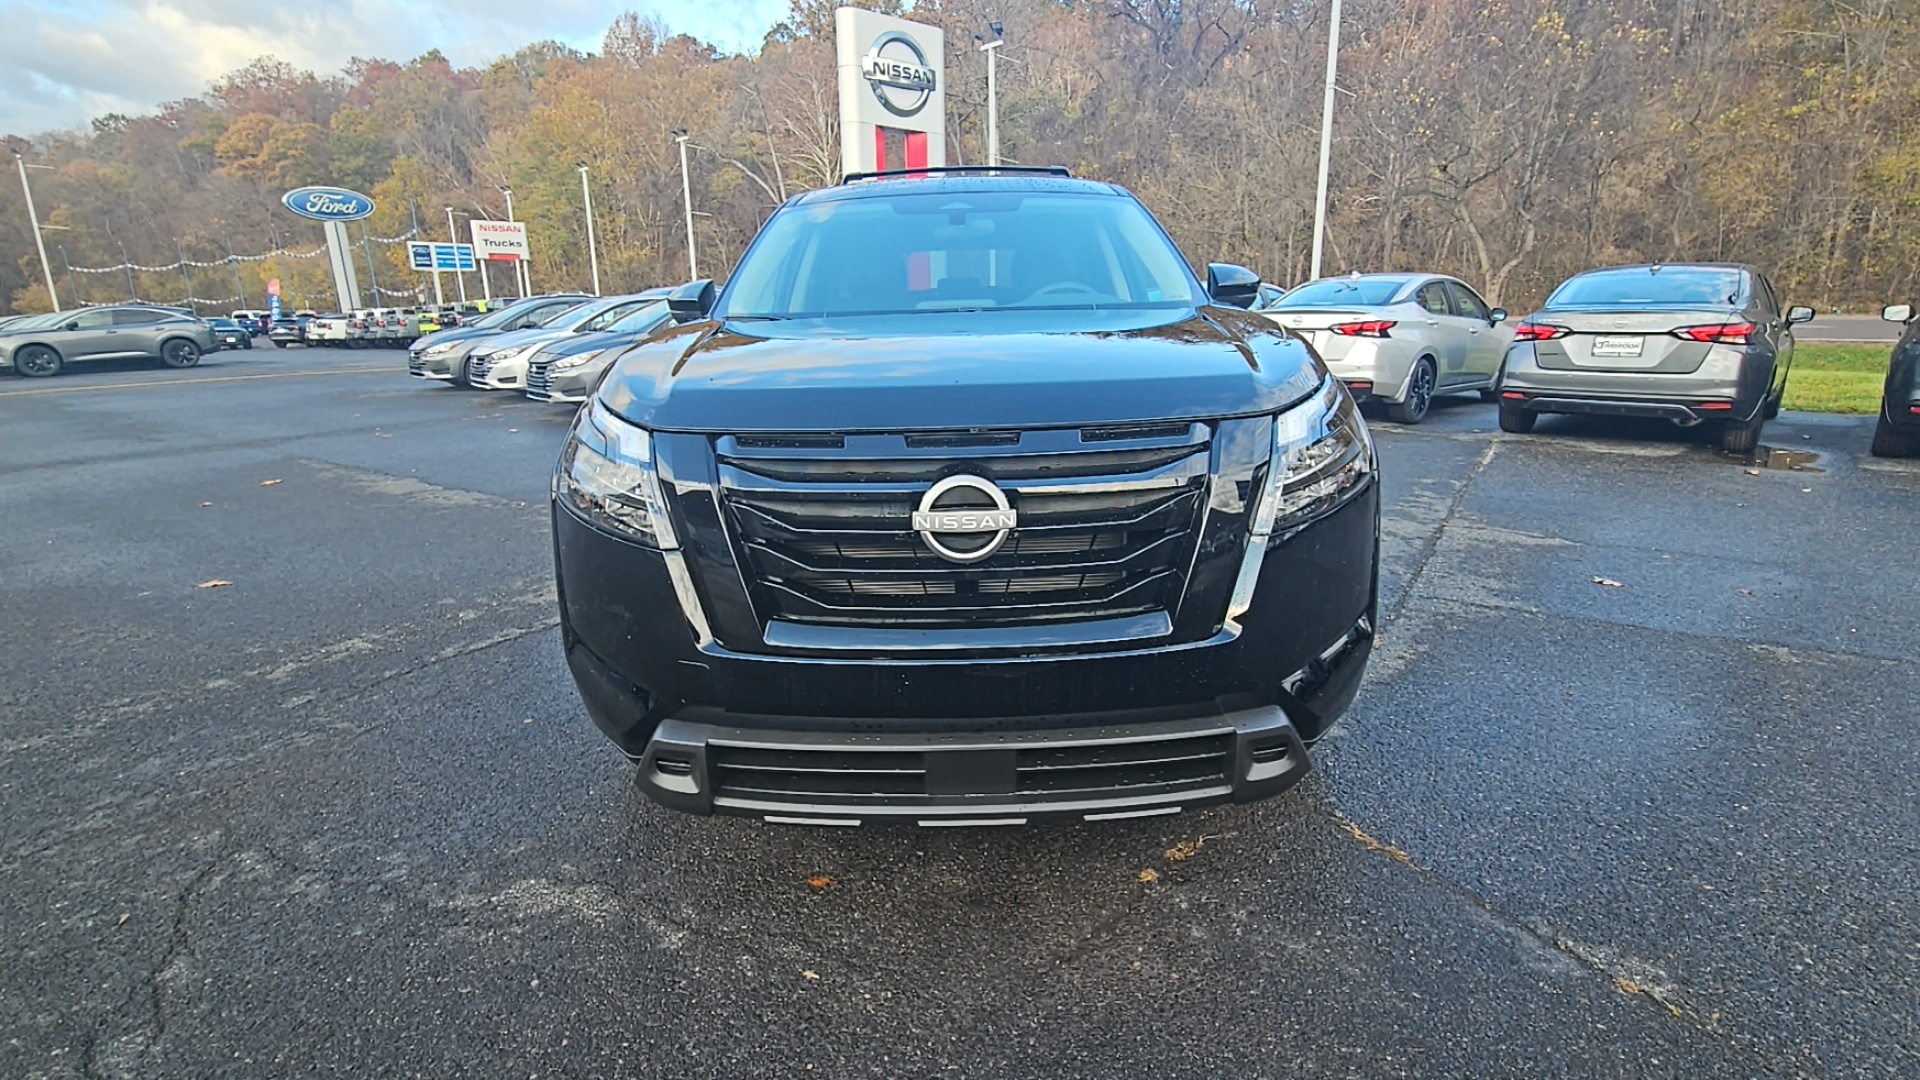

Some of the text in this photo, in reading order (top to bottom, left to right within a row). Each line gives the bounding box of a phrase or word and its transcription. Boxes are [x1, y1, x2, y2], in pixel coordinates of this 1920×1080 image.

[873, 62, 931, 84] NISSAN
[306, 193, 357, 214] Ford
[479, 224, 521, 233] NISSAN
[482, 238, 522, 247] Trucks
[915, 513, 1014, 529] NISSAN
